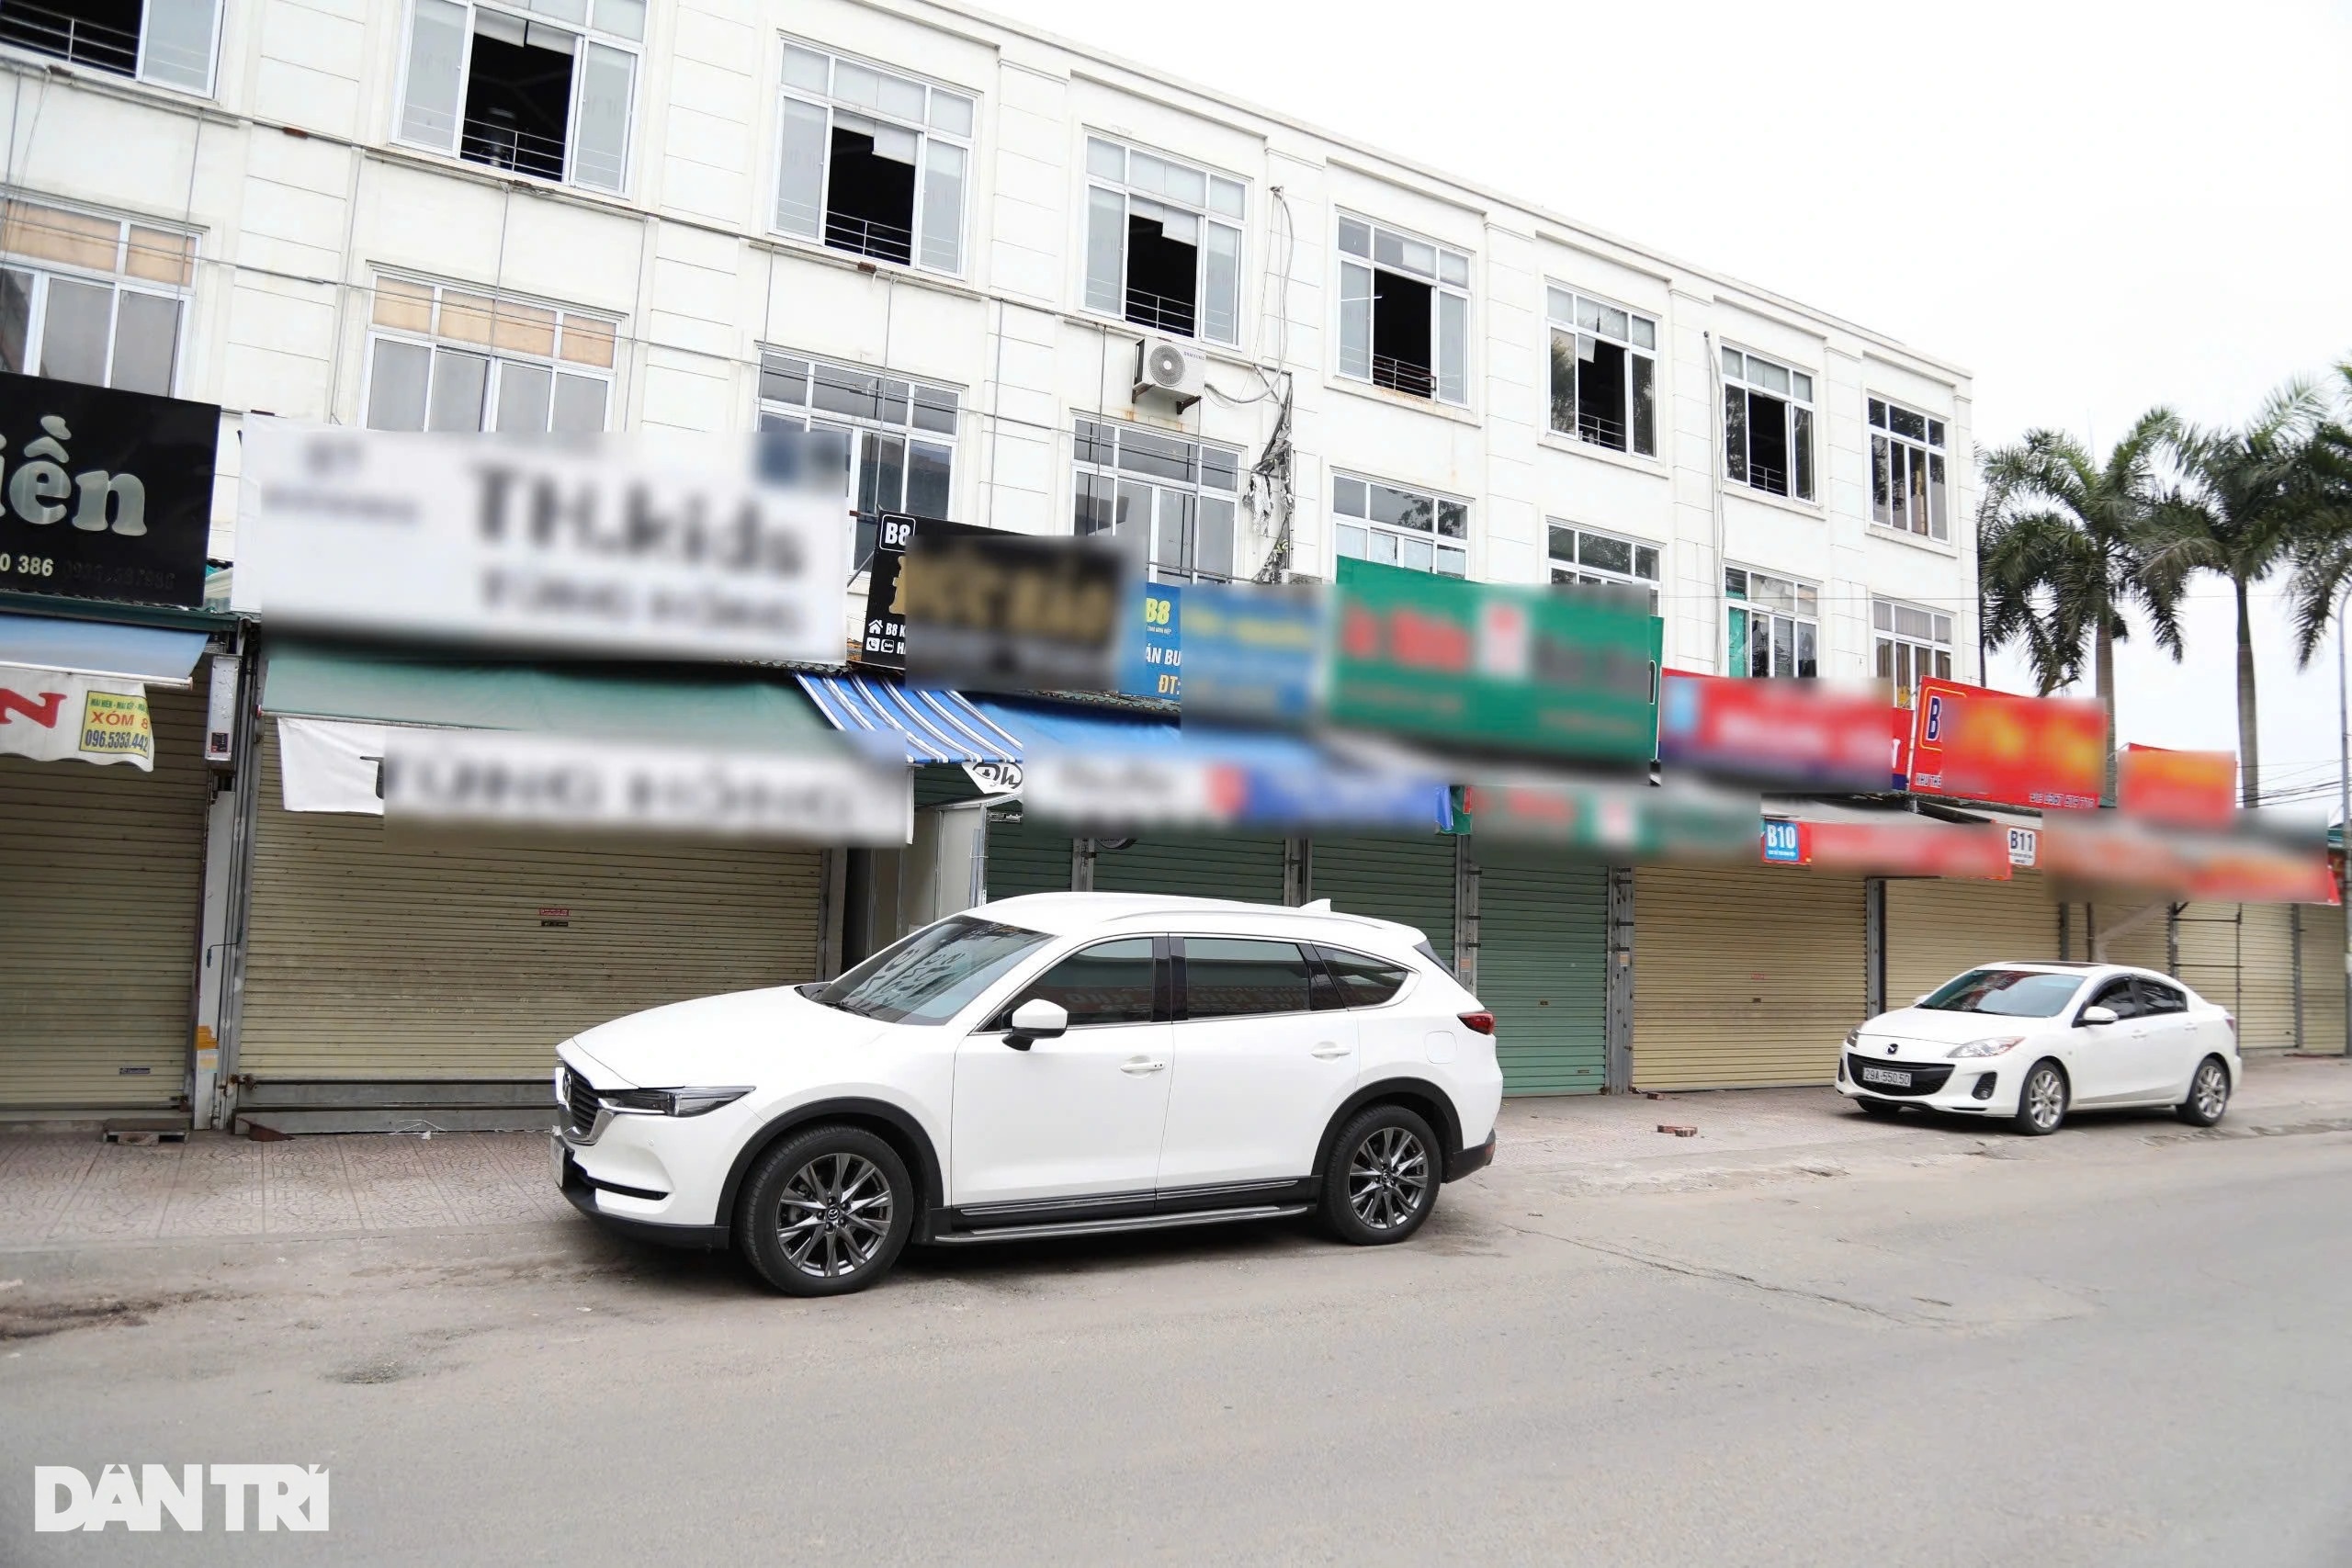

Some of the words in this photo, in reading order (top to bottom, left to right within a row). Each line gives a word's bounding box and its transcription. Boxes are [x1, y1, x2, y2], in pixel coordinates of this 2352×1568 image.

[17, 555, 54, 577] 386
[91, 710, 135, 727] XÓM
[1767, 824, 1796, 850] B10
[2010, 830, 2033, 852] B11
